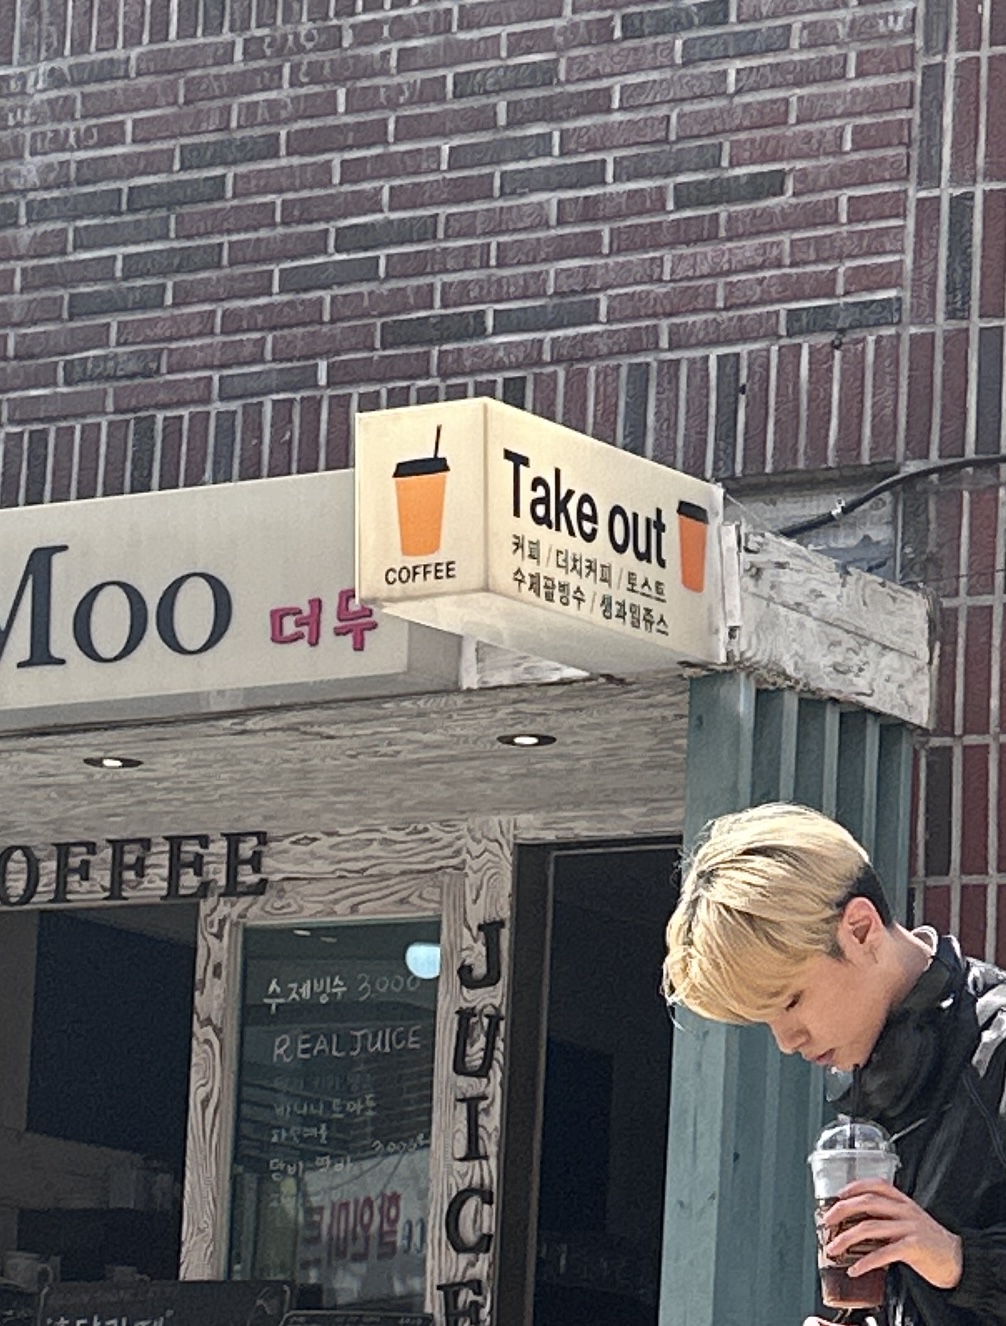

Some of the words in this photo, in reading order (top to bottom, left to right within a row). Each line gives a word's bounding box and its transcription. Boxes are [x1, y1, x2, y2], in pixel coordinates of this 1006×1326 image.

[502, 447, 599, 543] Take
[607, 503, 667, 569] out
[384, 560, 457, 585] COFFEE
[511, 533, 541, 567] 커피
[555, 548, 613, 588] 더치커피
[626, 570, 668, 603] 토스트
[262, 974, 348, 1015] 수제빙수
[272, 1031, 347, 1064] REAL
[348, 1024, 423, 1057] JUICE
